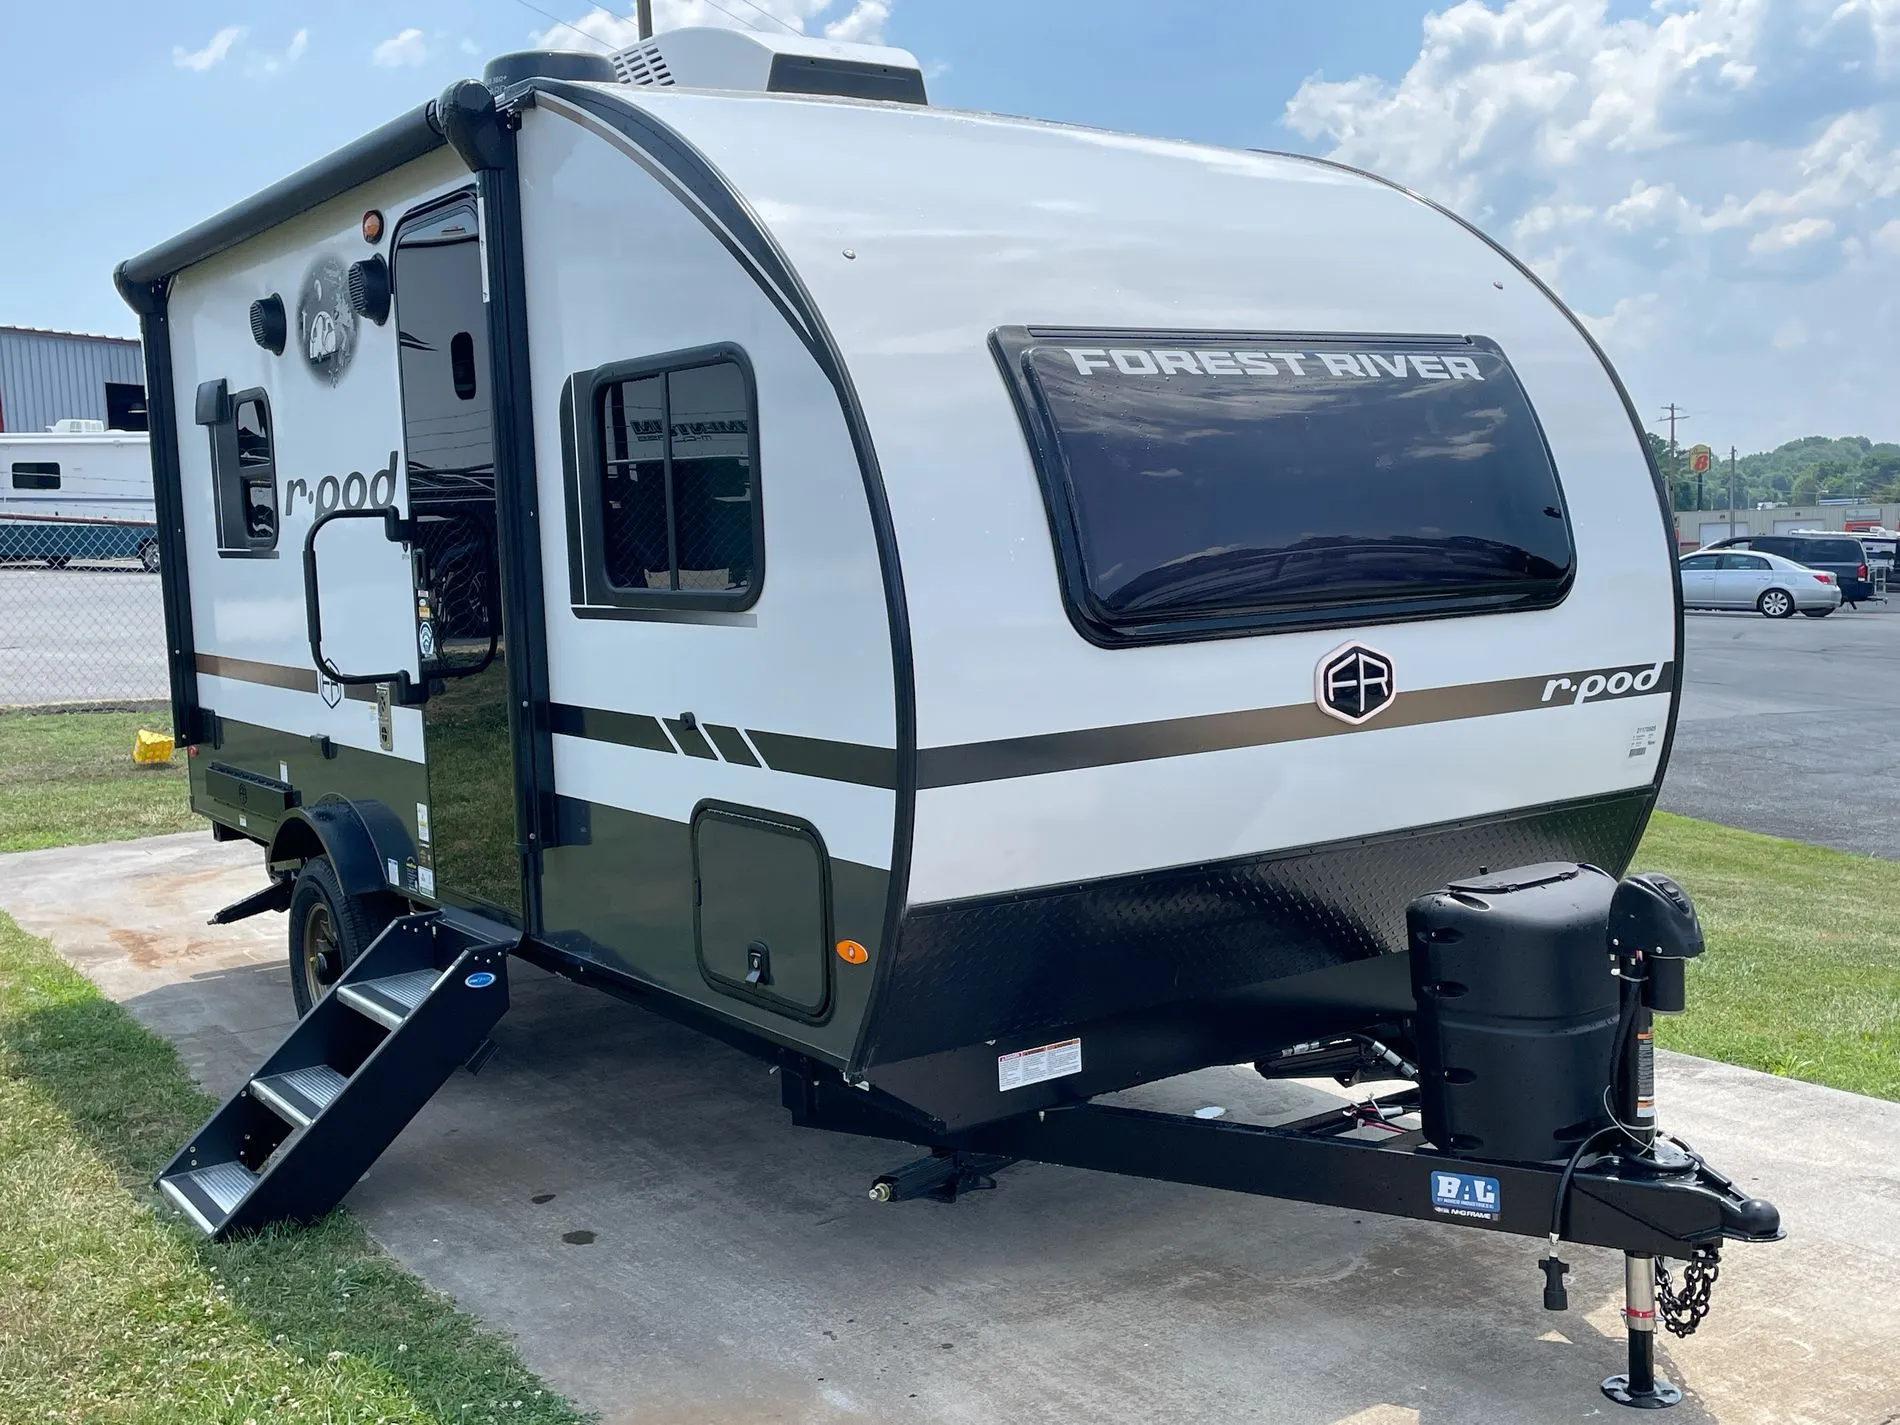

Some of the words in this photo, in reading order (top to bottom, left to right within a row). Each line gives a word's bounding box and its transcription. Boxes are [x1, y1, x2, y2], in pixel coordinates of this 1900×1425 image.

[1063, 348, 1307, 377] FOREST
[1314, 352, 1486, 382] RIVER
[1437, 1175, 1495, 1204] BAL
[1467, 1210, 1491, 1219] FRAME
